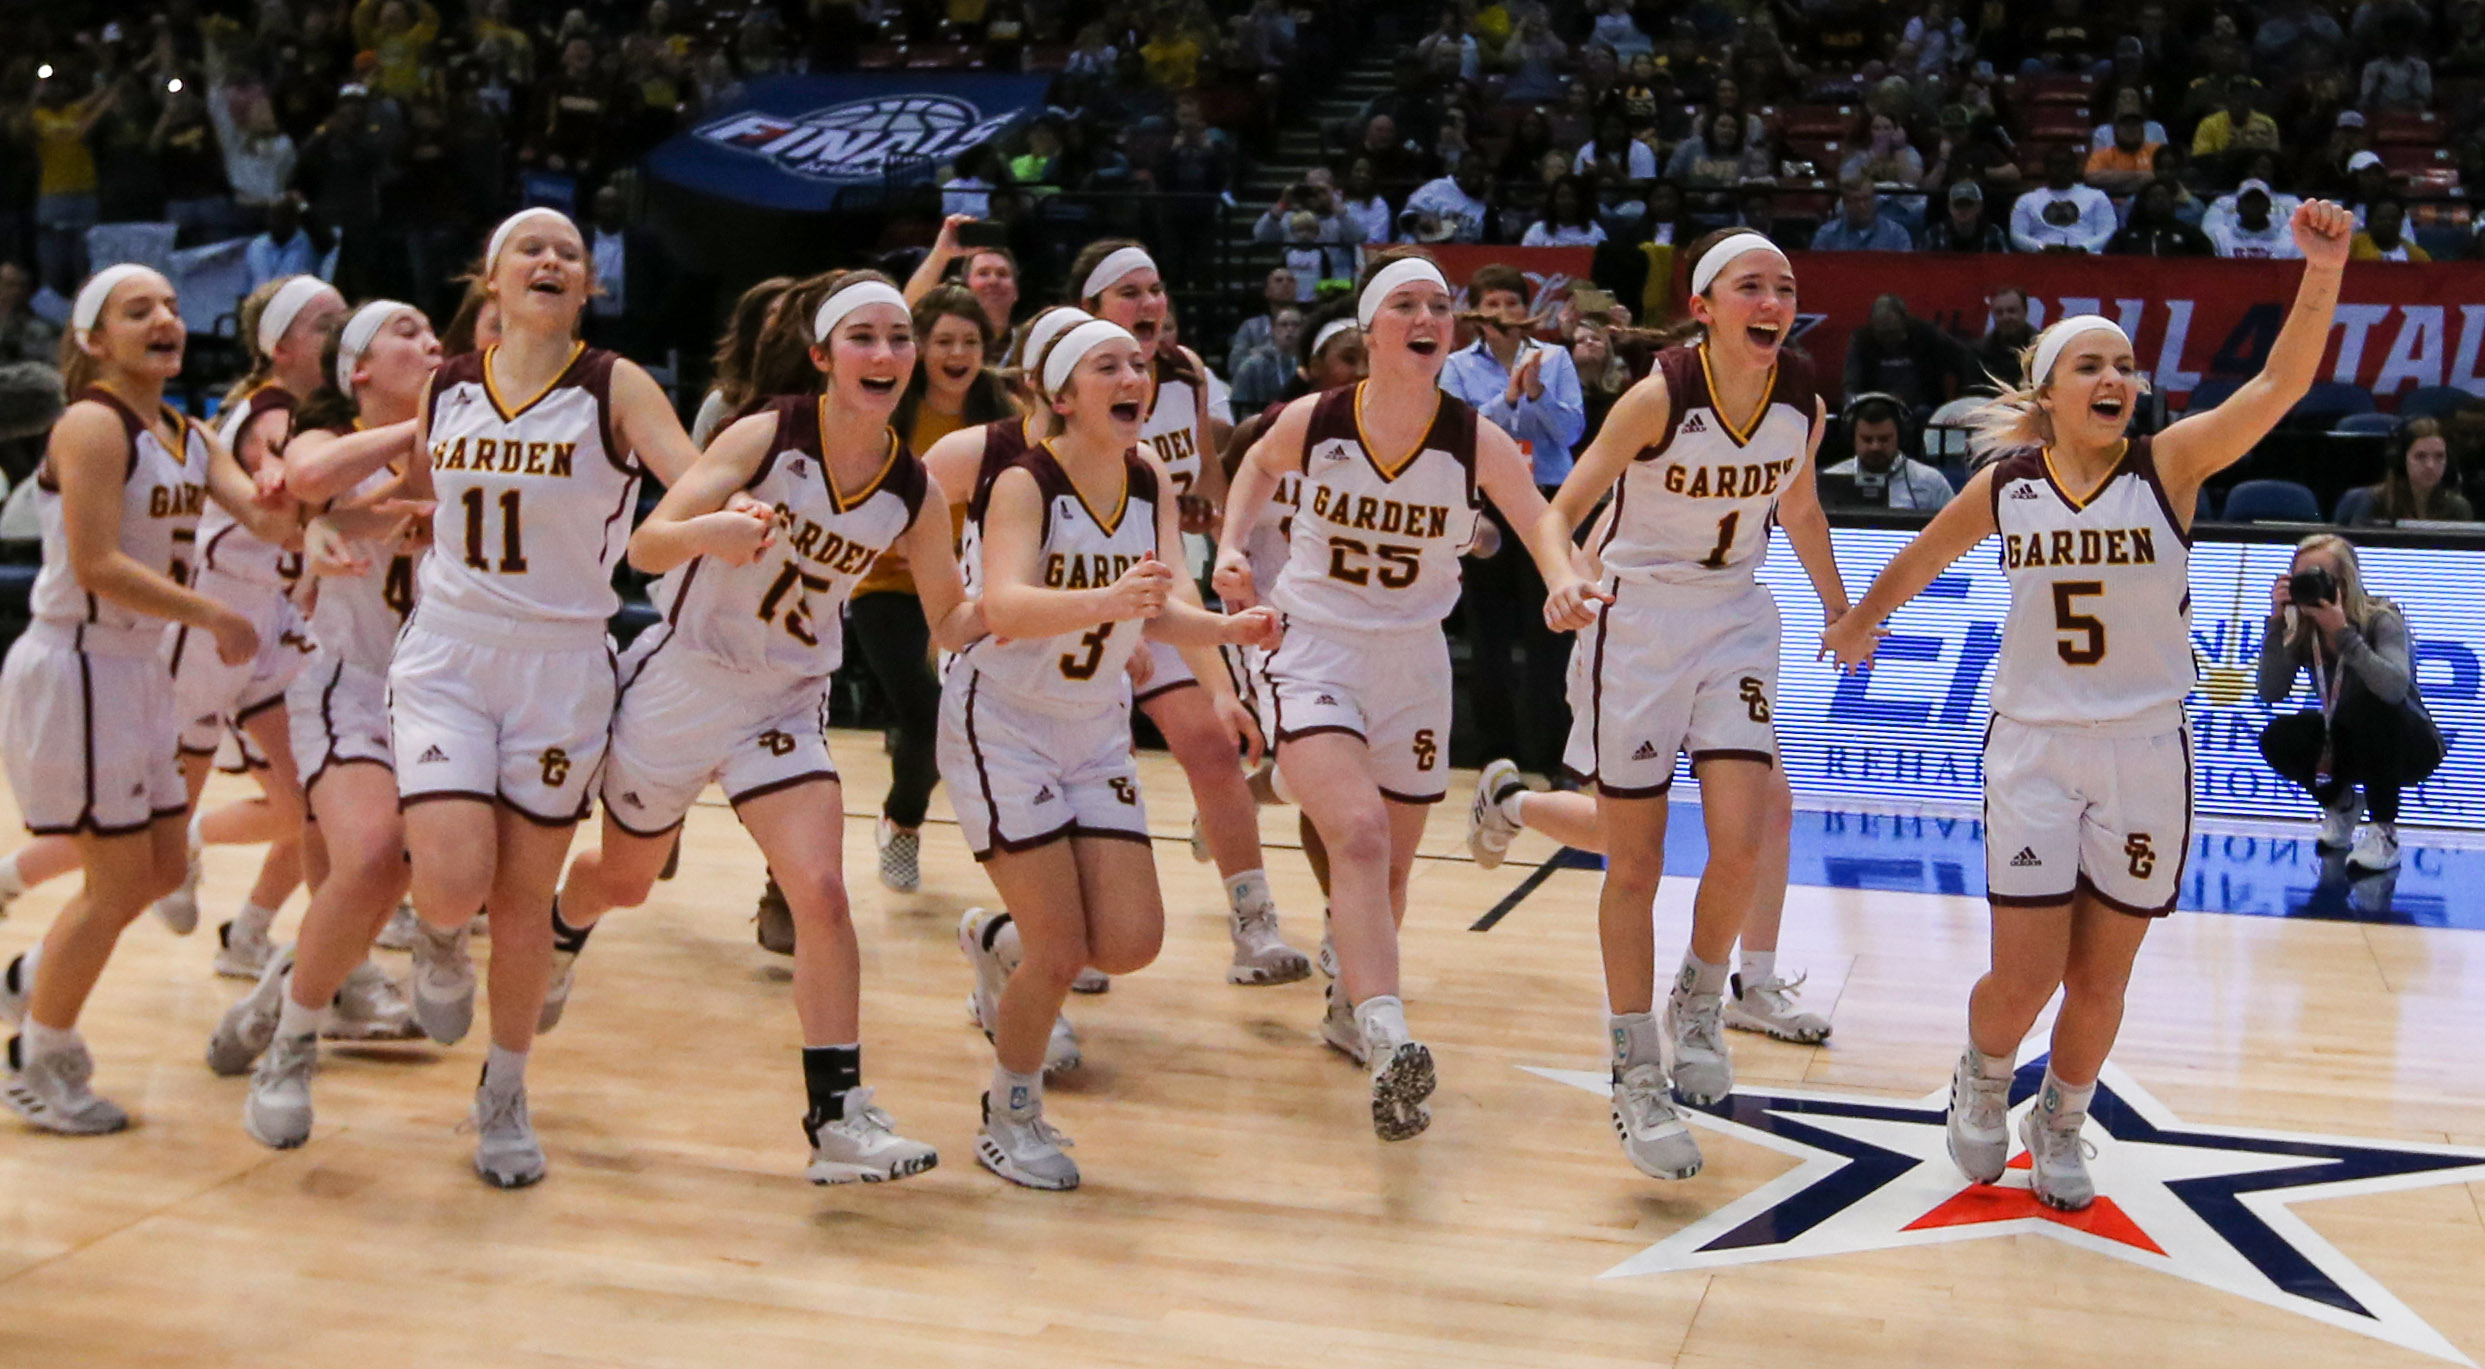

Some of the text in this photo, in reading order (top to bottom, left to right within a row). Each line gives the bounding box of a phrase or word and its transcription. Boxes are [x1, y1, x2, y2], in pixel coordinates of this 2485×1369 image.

[703, 105, 1026, 164] FINALS
[461, 484, 529, 574] 11
[774, 501, 879, 575] RDE
[1313, 483, 1450, 539] GARDEN
[1699, 509, 1741, 567] 1
[1043, 552, 1142, 589] GARD
[1328, 535, 1423, 590] 25
[2006, 526, 2157, 570] GARDEN
[757, 558, 833, 647] 15
[2051, 578, 2107, 668] 5
[1058, 621, 1116, 681] 3
[1827, 746, 1984, 783] REHA
[2123, 832, 2157, 881] SG
